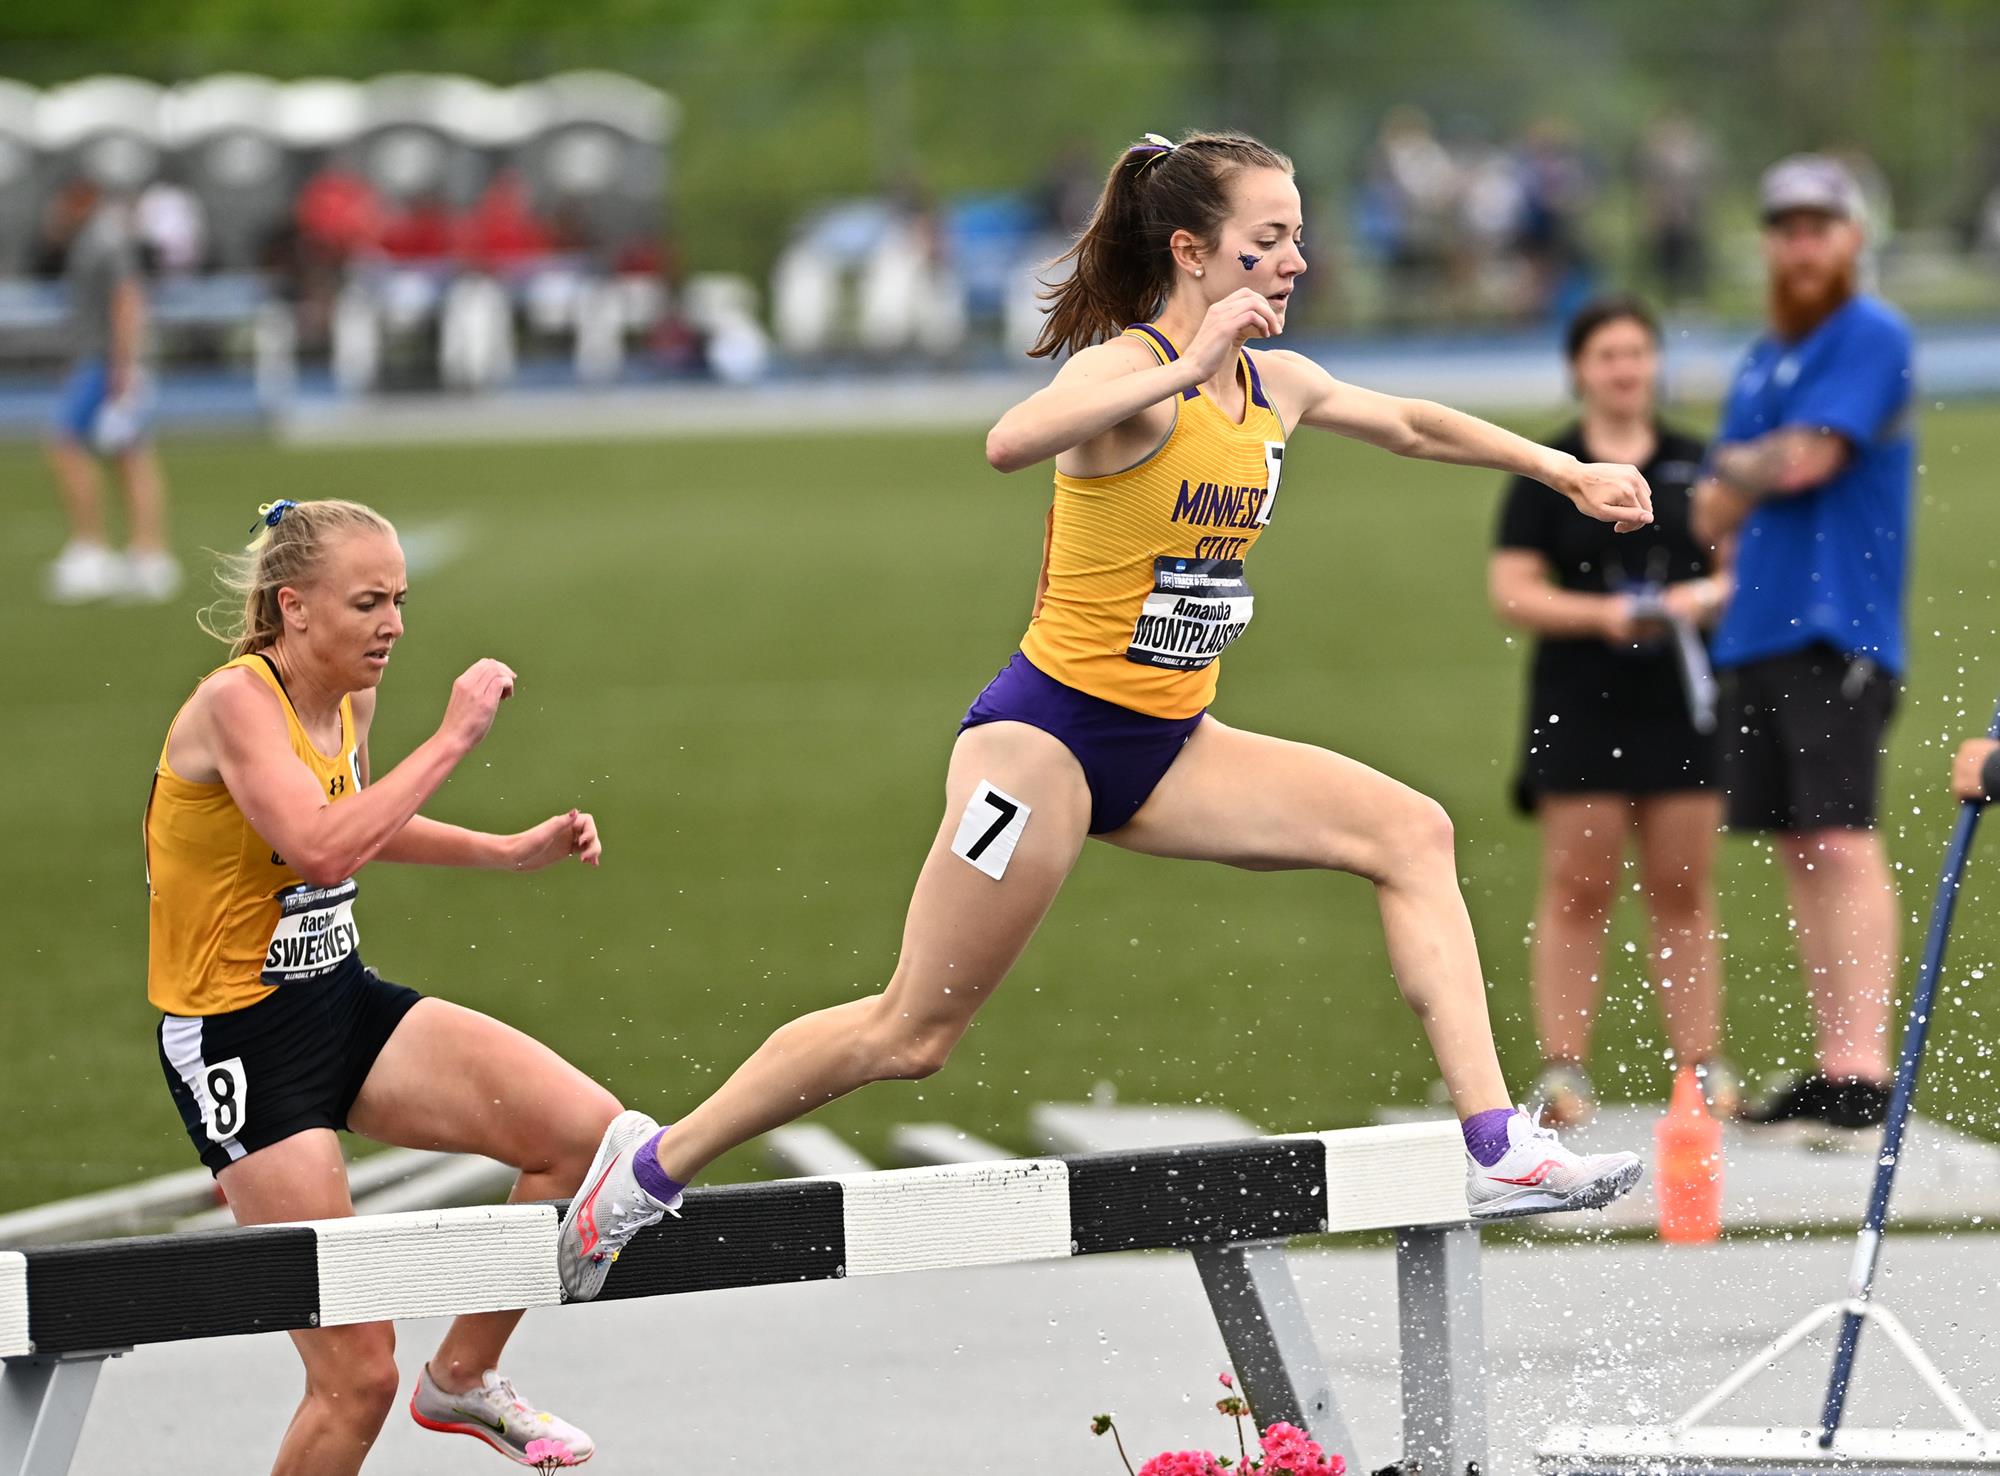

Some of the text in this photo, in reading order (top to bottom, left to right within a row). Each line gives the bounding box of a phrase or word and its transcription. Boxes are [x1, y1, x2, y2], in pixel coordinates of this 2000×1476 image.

[1171, 479, 1268, 530] MINNESO
[1172, 598, 1231, 621] Amanda
[1132, 615, 1246, 654] MONTPLAISIR
[966, 791, 1018, 861] 7
[265, 922, 355, 968] SWEENEY
[207, 1068, 237, 1135] 8
